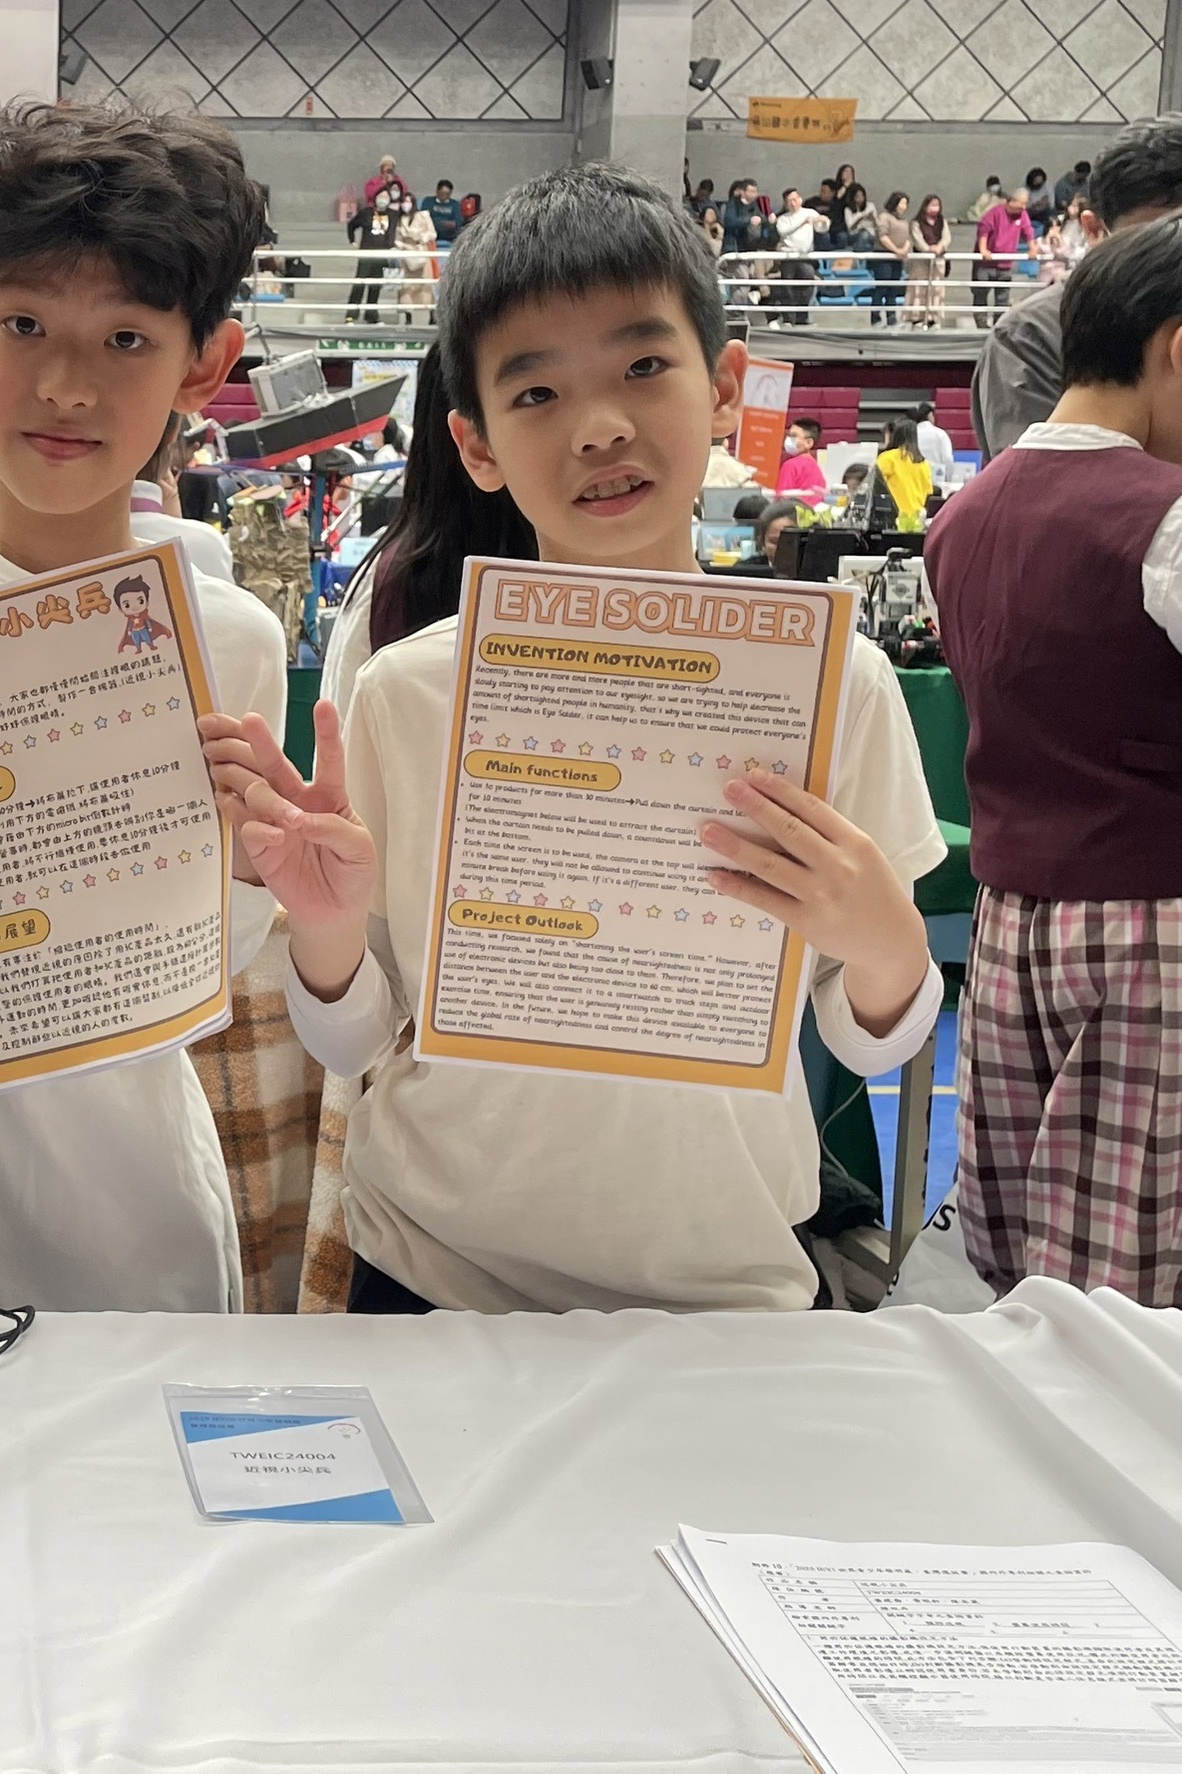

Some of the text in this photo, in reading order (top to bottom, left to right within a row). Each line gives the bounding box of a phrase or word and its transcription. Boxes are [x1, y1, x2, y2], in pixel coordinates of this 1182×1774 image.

[494, 578, 819, 647] EYE SOLIDER
[486, 640, 712, 675] INVENTION MOTIVATION
[486, 758, 599, 783] Main functions
[461, 908, 583, 931] Project Outlook
[229, 1451, 337, 1461] TWEIC24004
